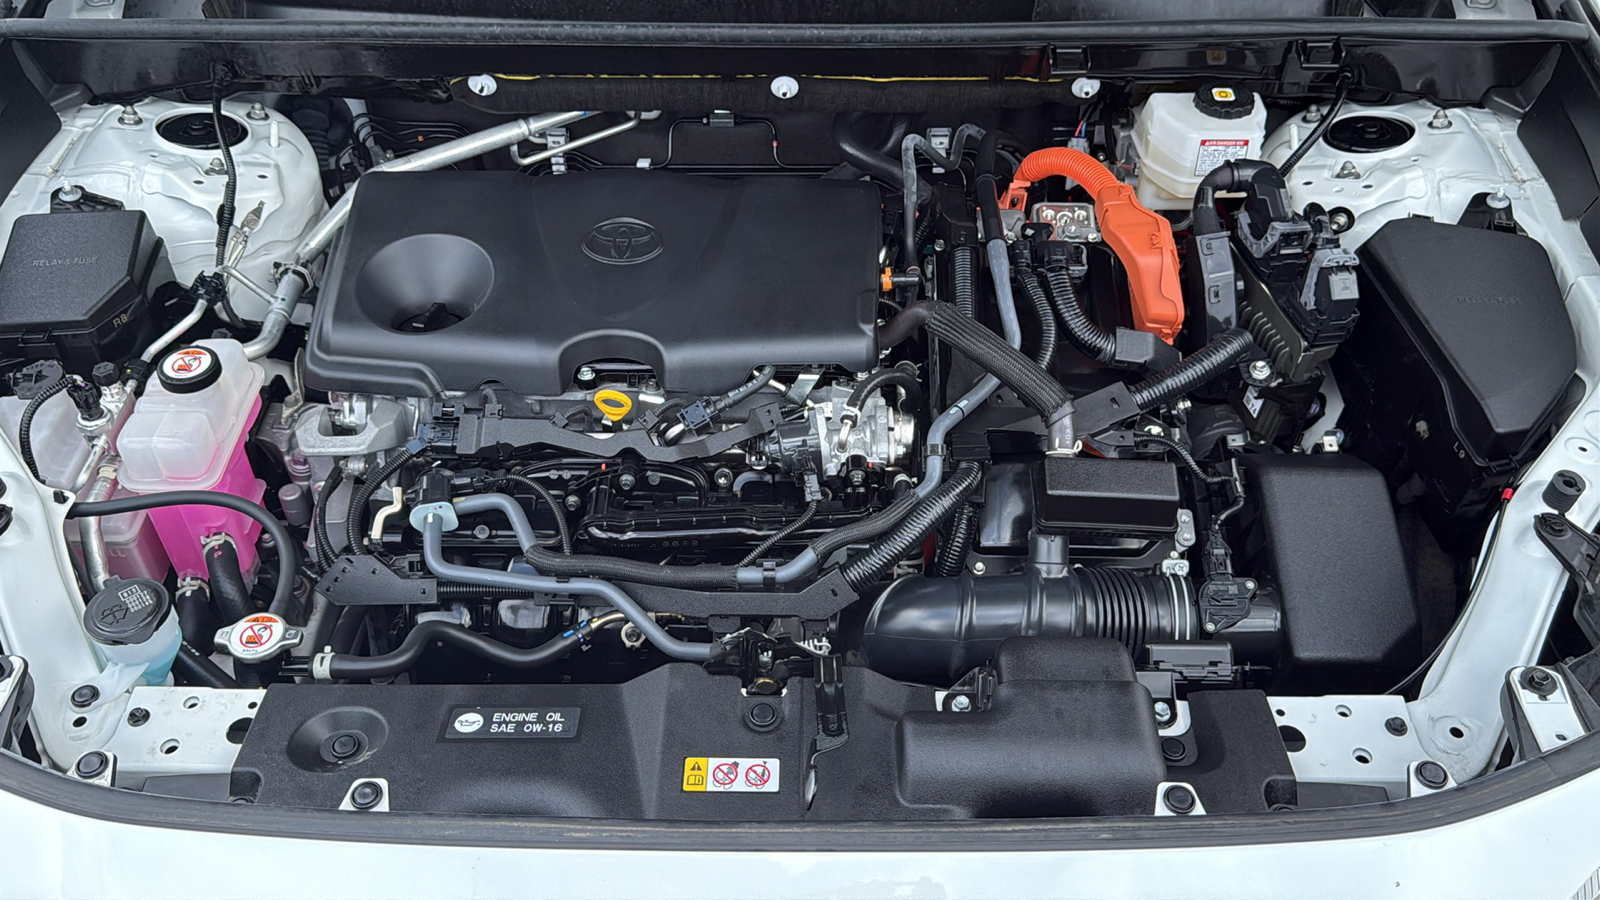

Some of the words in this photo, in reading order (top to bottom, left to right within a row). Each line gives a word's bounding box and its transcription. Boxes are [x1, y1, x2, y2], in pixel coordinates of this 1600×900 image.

[32, 259, 63, 267] RELAY
[73, 256, 98, 264] FUSE
[113, 313, 128, 328] R8
[492, 712, 538, 722] ENGINE
[545, 712, 565, 722] OIL
[490, 723, 516, 733] SAE
